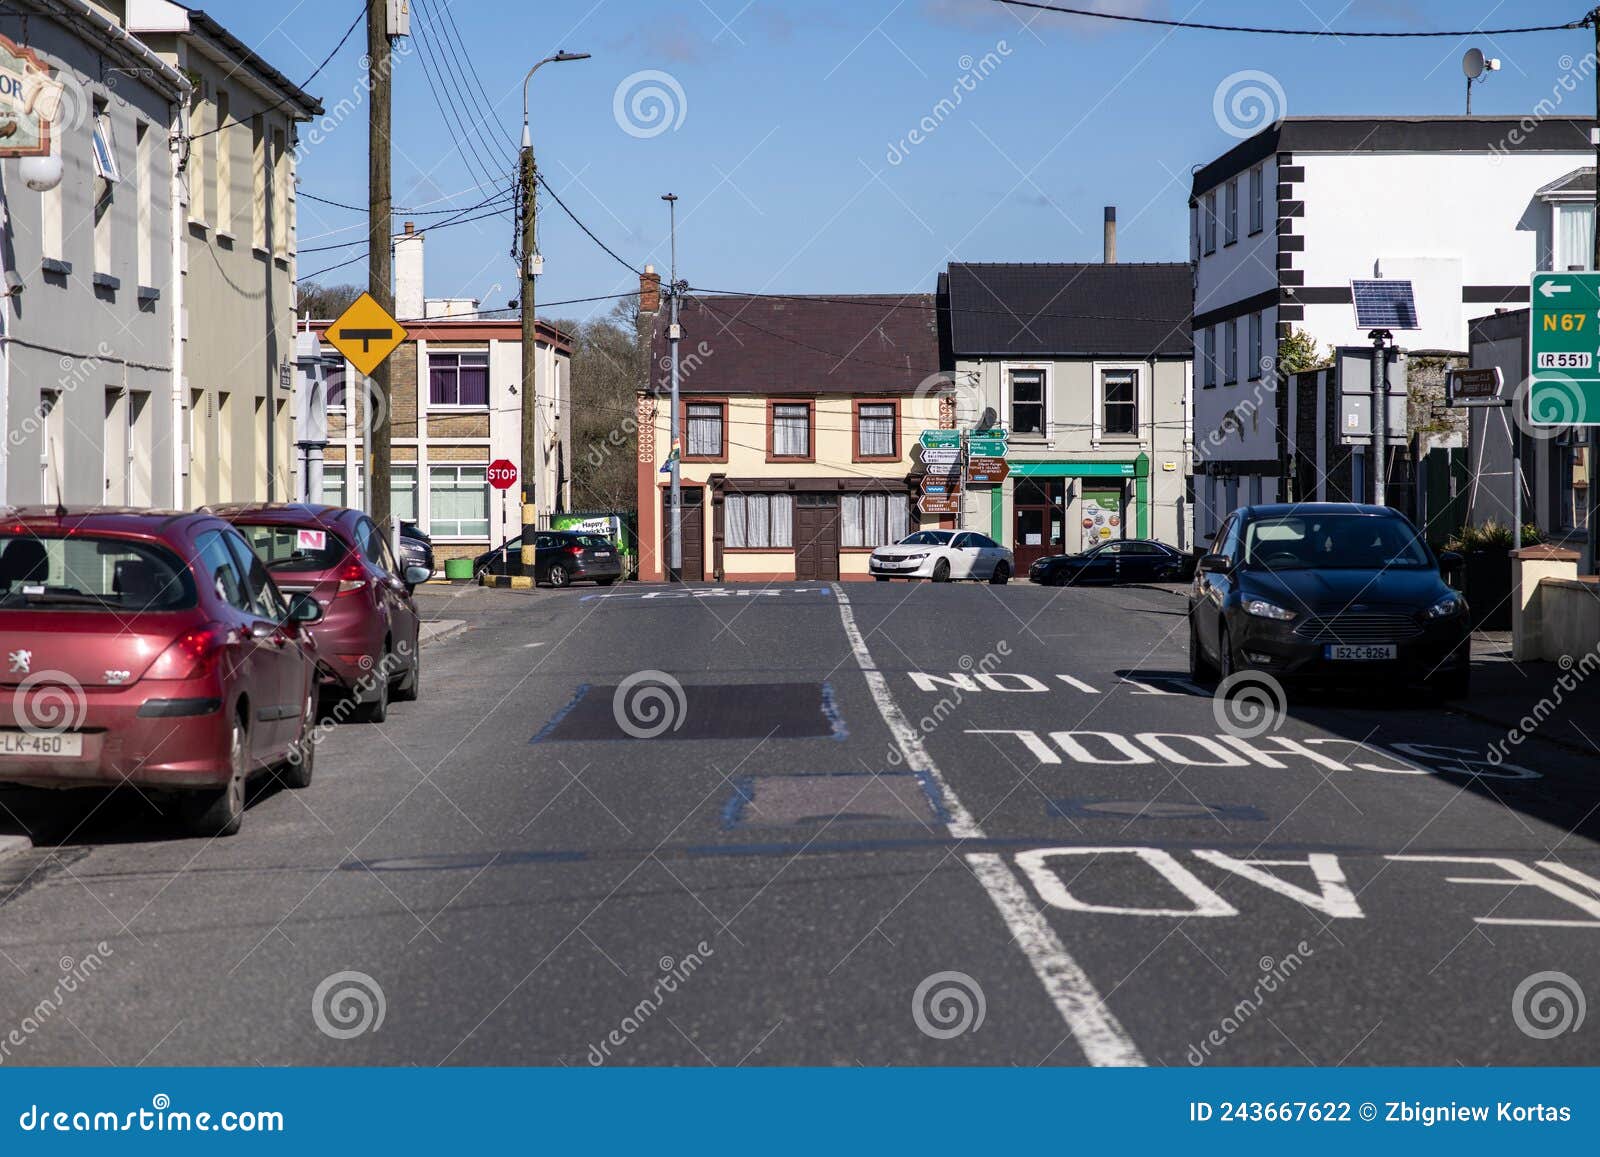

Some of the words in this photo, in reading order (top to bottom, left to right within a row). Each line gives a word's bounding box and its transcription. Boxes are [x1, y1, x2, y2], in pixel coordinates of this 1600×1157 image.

[1543, 314, 1557, 331] N
[1561, 314, 1586, 331] 67
[1558, 354, 1589, 367] 551)
[488, 468, 516, 480] STOP
[606, 527, 618, 535] Day
[300, 531, 322, 548] N
[1335, 647, 1391, 659] 152-C-8264
